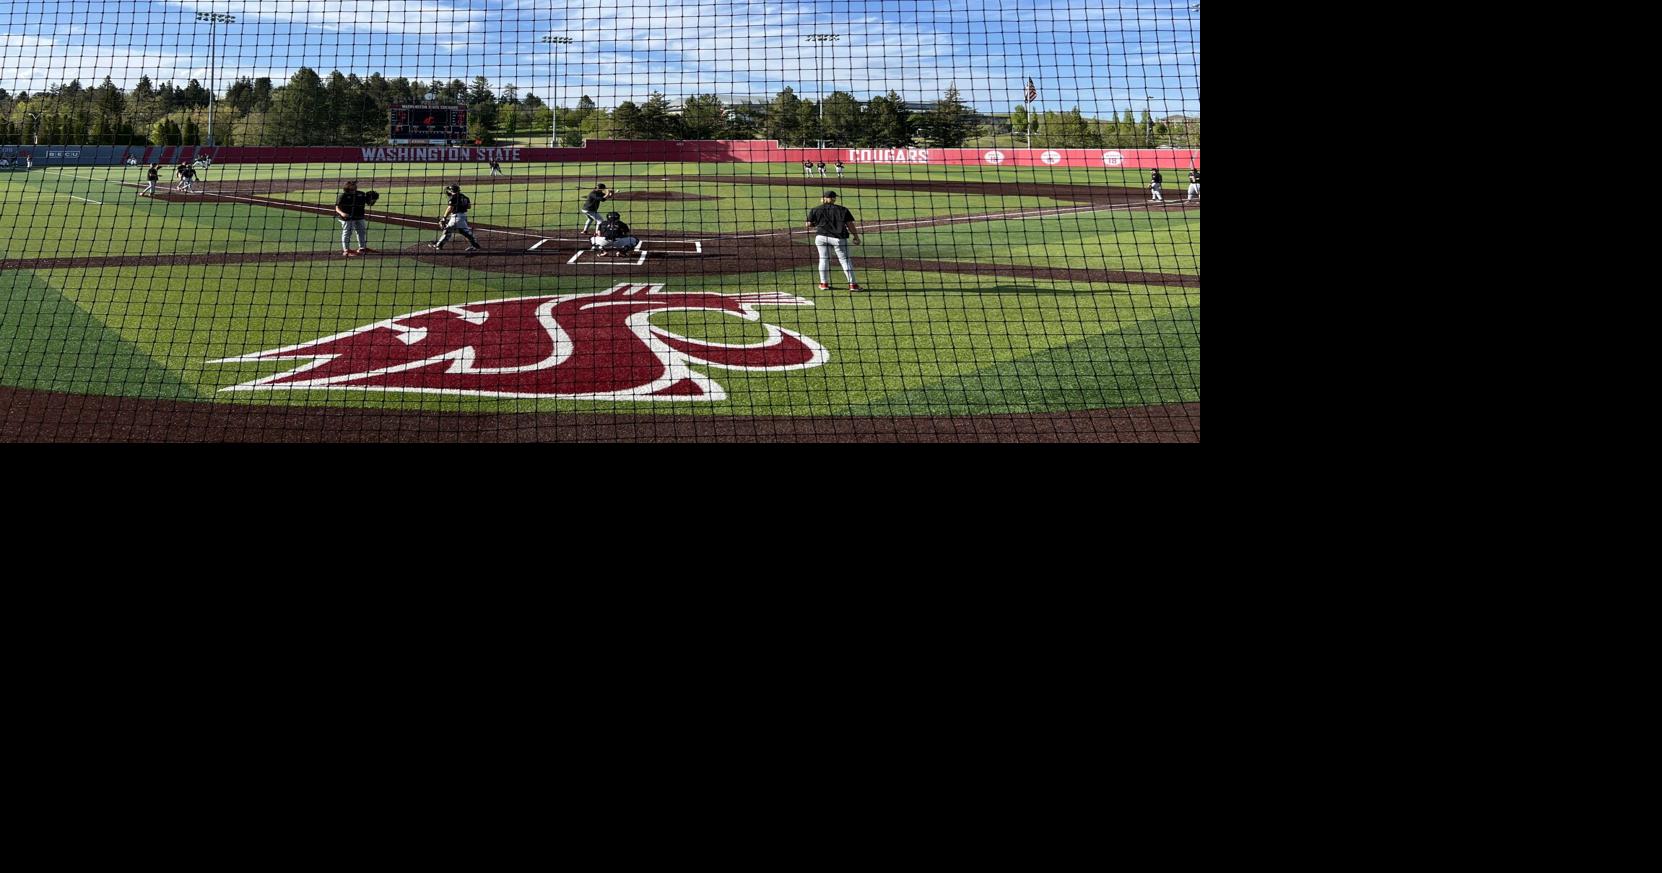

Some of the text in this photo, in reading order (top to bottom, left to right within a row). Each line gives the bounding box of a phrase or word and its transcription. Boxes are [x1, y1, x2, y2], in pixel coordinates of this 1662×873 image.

[361, 147, 520, 161] WASHINGTON STATE
[848, 149, 929, 163] COUGARS
